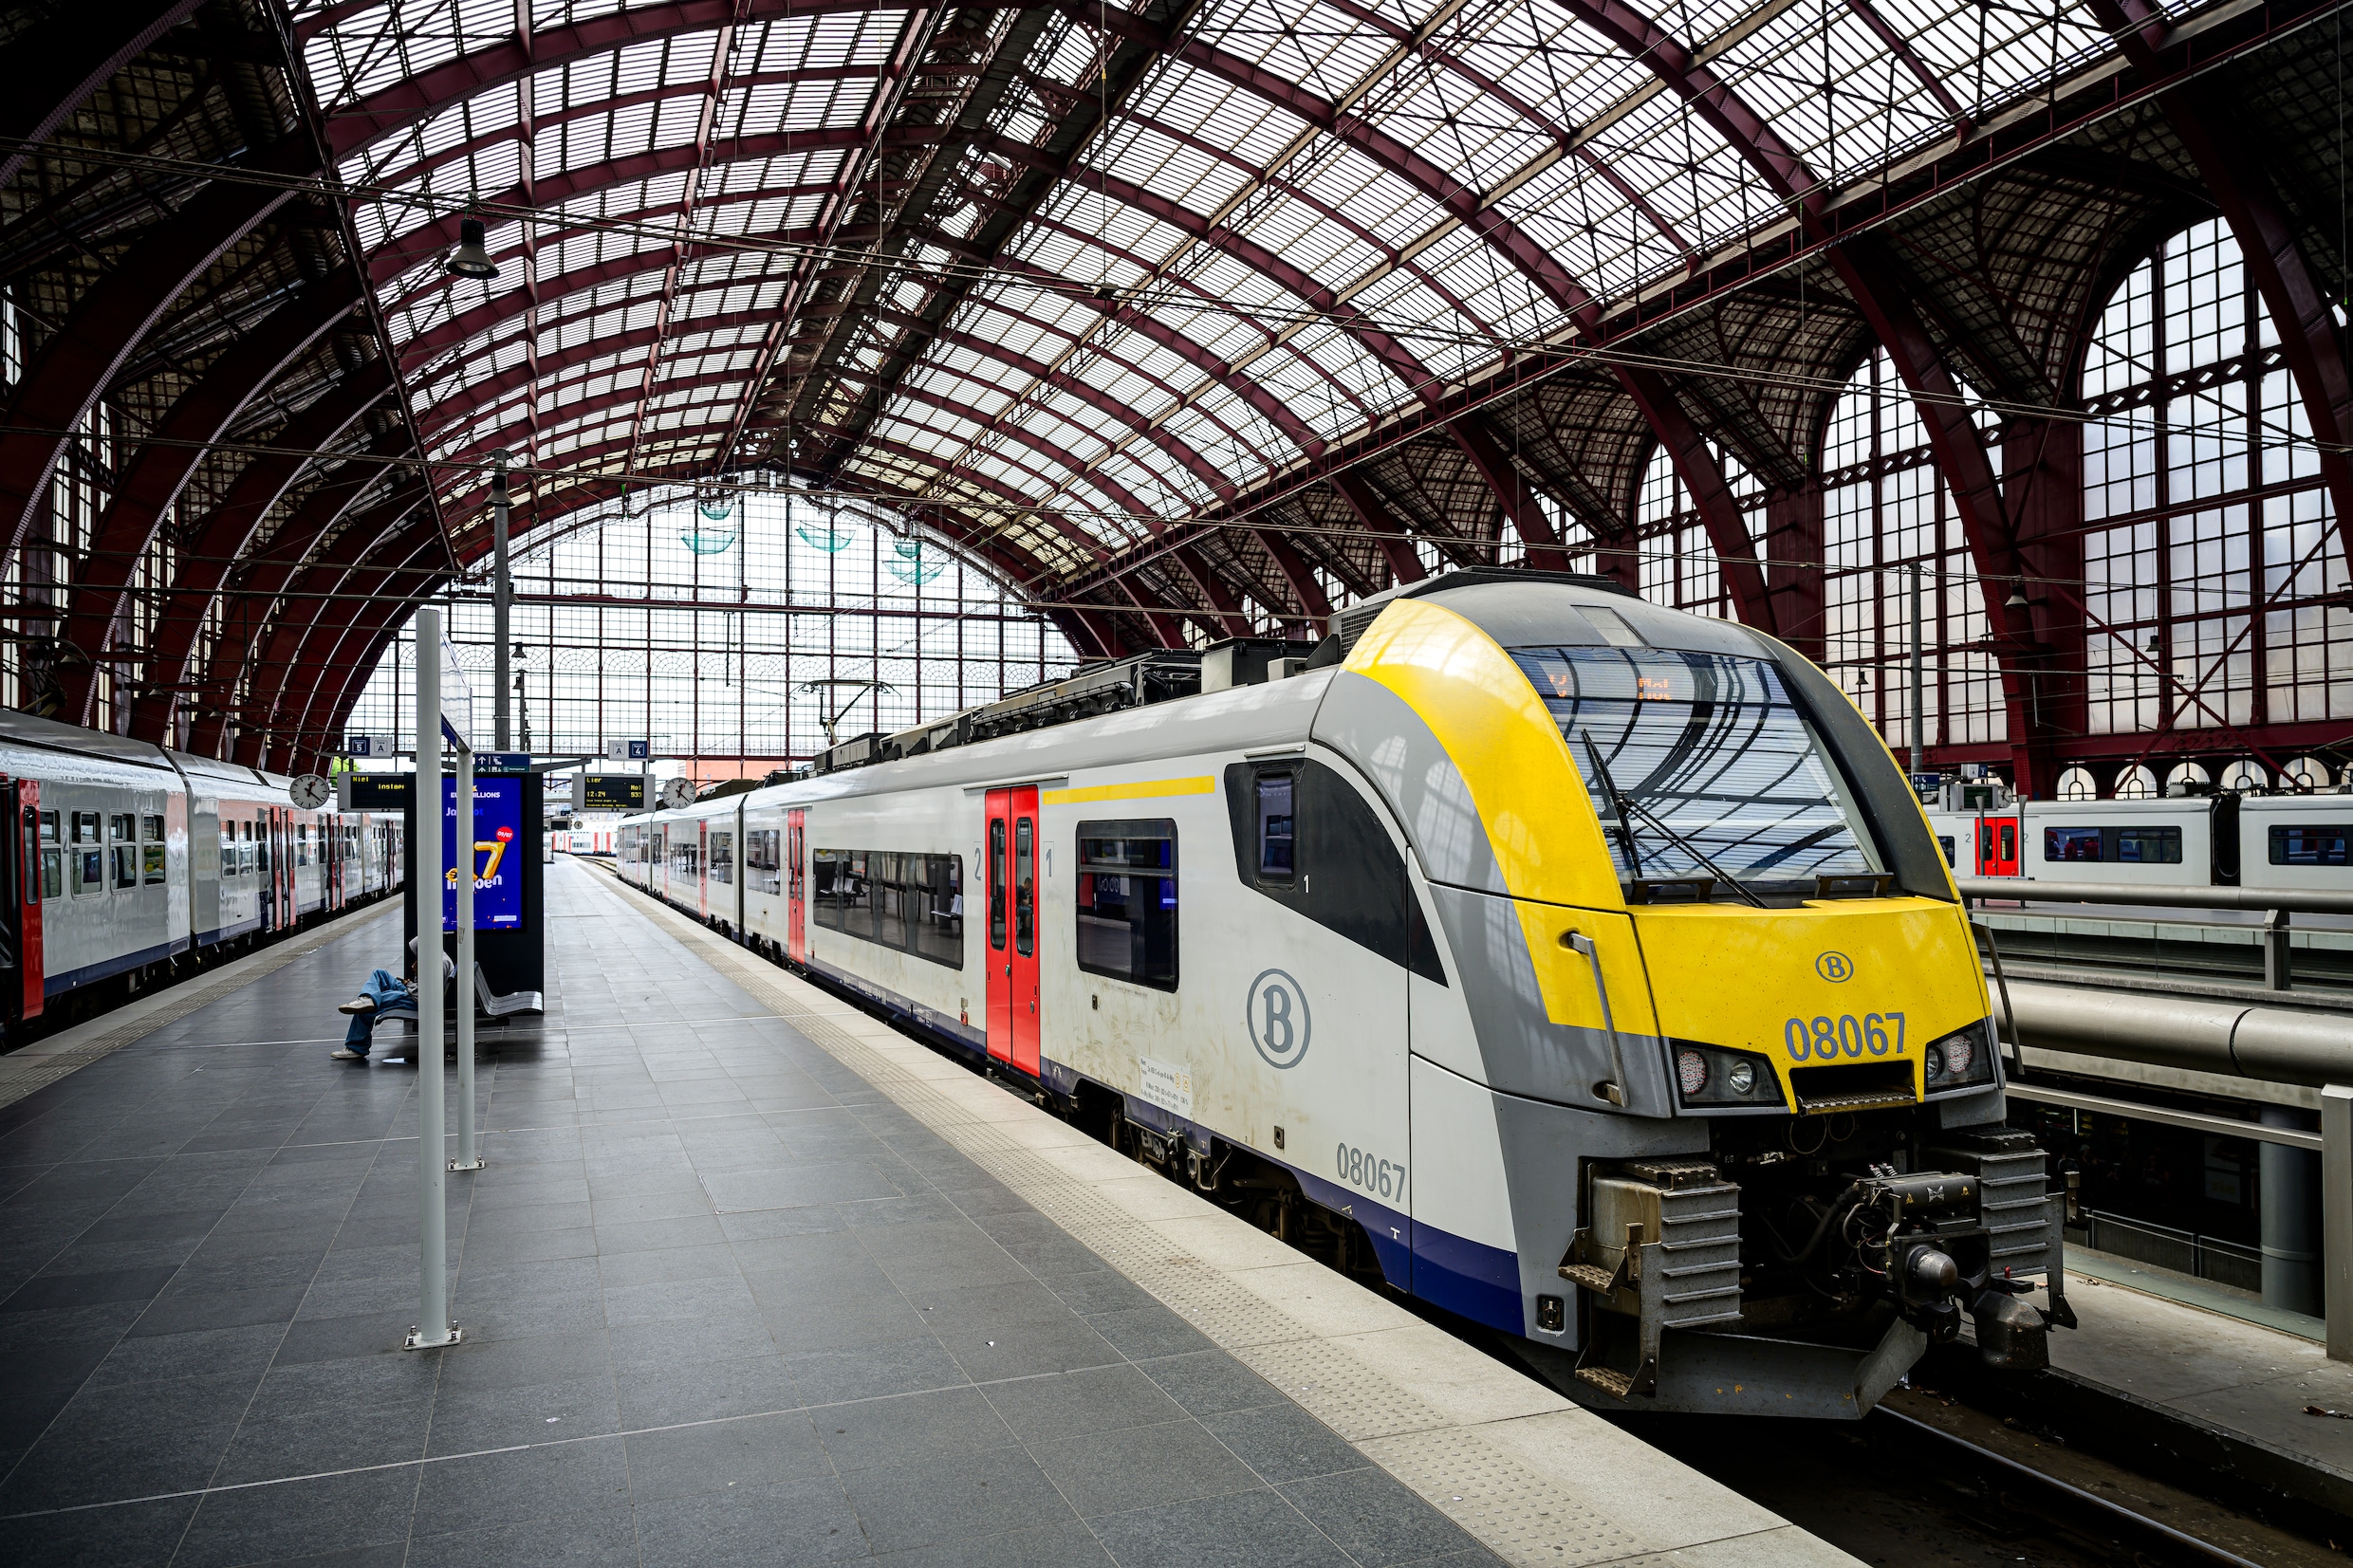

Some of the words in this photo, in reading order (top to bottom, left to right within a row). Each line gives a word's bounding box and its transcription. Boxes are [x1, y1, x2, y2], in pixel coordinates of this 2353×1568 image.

[356, 744, 362, 752] 5
[445, 806, 484, 817] Jaot
[1965, 833, 1972, 843] 2
[973, 847, 982, 881] 2
[1046, 848, 1052, 878] 1
[1785, 1011, 1906, 1061] 08067
[1337, 1142, 1406, 1203] 08067
